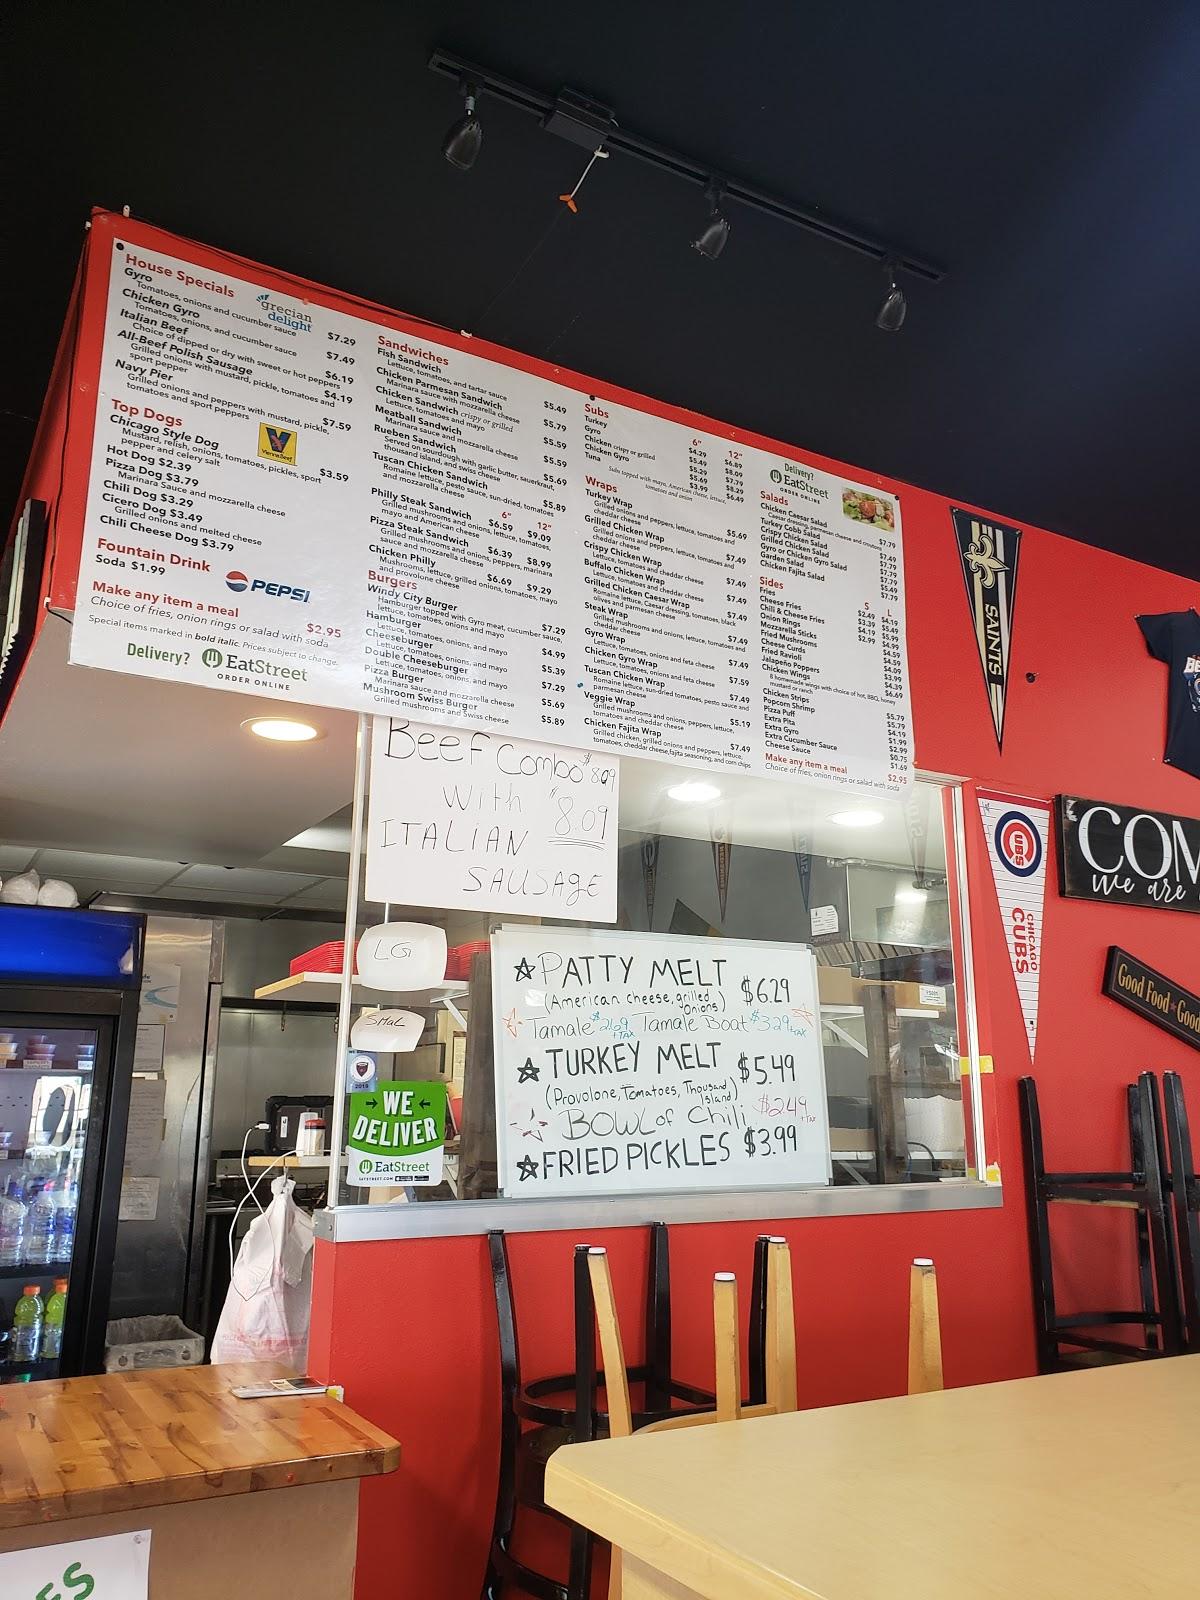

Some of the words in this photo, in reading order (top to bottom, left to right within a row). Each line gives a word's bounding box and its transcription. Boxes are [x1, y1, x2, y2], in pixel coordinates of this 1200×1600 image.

[124, 268, 152, 282] Gyro
[126, 254, 172, 277] House
[177, 271, 234, 298] Specials
[122, 288, 170, 310] Chicken
[172, 302, 200, 319] Gyro
[137, 281, 181, 301] Tomatoes,
[184, 296, 212, 311] onions
[214, 305, 229, 316] and
[232, 310, 272, 330] cucumber
[274, 324, 297, 337] sauce
[261, 300, 312, 323] grecian
[120, 309, 158, 328] Italian
[161, 320, 189, 335] Beef
[268, 312, 312, 332] delight
[328, 332, 356, 347] $7.29
[326, 351, 355, 366] $7.49
[377, 348, 396, 360] Fish
[398, 353, 442, 373] Sandwich
[378, 336, 449, 366] Sandwiches
[115, 359, 147, 376] Navy
[150, 368, 174, 382] Pier
[325, 370, 354, 384] $6.19
[376, 386, 413, 403] Chicken
[415, 397, 458, 416] Sandwich
[544, 401, 567, 414] $5.49
[584, 404, 609, 418] Subs
[111, 399, 139, 417] Top
[144, 408, 182, 428] Dogs
[585, 415, 608, 428] Turkey
[110, 414, 160, 436] Chicago
[162, 428, 192, 444] Style
[195, 436, 219, 451] Dog
[322, 418, 351, 432] $7.59
[544, 438, 567, 450] $5.59
[585, 475, 617, 493] Wraps
[784, 475, 828, 499] EatStreet
[586, 489, 610, 502] Turkey
[612, 497, 632, 509] Wrap
[760, 491, 788, 506] Salads
[761, 503, 787, 515] Chicken
[788, 510, 809, 522] Caesar
[811, 518, 827, 528] Salad
[727, 530, 747, 540] $5.69
[879, 539, 896, 549] $7.79
[96, 554, 126, 568] Soda
[131, 561, 166, 576] $1.99
[98, 538, 164, 562] Fountain
[170, 554, 210, 572] Drink
[368, 570, 417, 591] Burgers
[760, 577, 783, 590] Sides
[760, 587, 775, 596] Fries
[93, 581, 131, 598] Make
[135, 589, 159, 604] any
[163, 593, 195, 610] item
[208, 604, 239, 618] meal
[251, 580, 310, 604] PEPSI
[367, 584, 401, 600] Windy
[403, 592, 423, 604] City
[425, 597, 457, 612] Burger
[306, 623, 342, 638] $2.95
[367, 610, 421, 629] Hamburger
[542, 624, 566, 635] $7.29
[585, 628, 604, 638] Gyro
[606, 632, 625, 644] Wrap
[761, 638, 786, 649] Cheese
[787, 644, 806, 654] Curds
[984, 603, 1002, 675] SAINTS
[127, 643, 190, 665] Delivery?
[542, 648, 566, 660] $4.99
[728, 659, 748, 669] $7.49
[226, 654, 308, 682] EatStreet
[217, 673, 250, 686] ORDER
[254, 680, 290, 691] ONLINE
[584, 691, 612, 705] Veggie
[615, 697, 635, 708] Wrap
[763, 688, 789, 699] Chicken
[791, 693, 809, 704] Strips
[886, 713, 904, 721] $5.79
[497, 743, 584, 783] Combo
[765, 753, 787, 764] Make
[789, 759, 803, 768] any
[805, 761, 822, 770] item
[830, 766, 847, 774] meal
[888, 774, 907, 784] $2.95
[1093, 874, 1135, 896] we
[1148, 878, 1186, 903] are
[374, 939, 412, 960] LG
[1012, 907, 1029, 974] CUBS
[1027, 913, 1038, 972] CHICAGO
[538, 951, 634, 989] PATTY
[649, 959, 727, 988] MELT
[741, 975, 790, 1006] $6.29
[1118, 963, 1145, 998] Good
[1146, 980, 1170, 1013] Food
[526, 1016, 594, 1041] Tamale
[632, 1011, 698, 1034] Tamale
[705, 1014, 748, 1032] Boat
[545, 1040, 641, 1079] TURKEY
[657, 1042, 721, 1074] MELT
[737, 1052, 795, 1085] $5.49
[383, 1090, 414, 1116] WE
[352, 1115, 438, 1148] DELIVER
[744, 1125, 797, 1158] $3.99
[542, 1147, 619, 1180] FRIED
[627, 1131, 730, 1171] PICKLES
[375, 1162, 429, 1172] EatStreet
